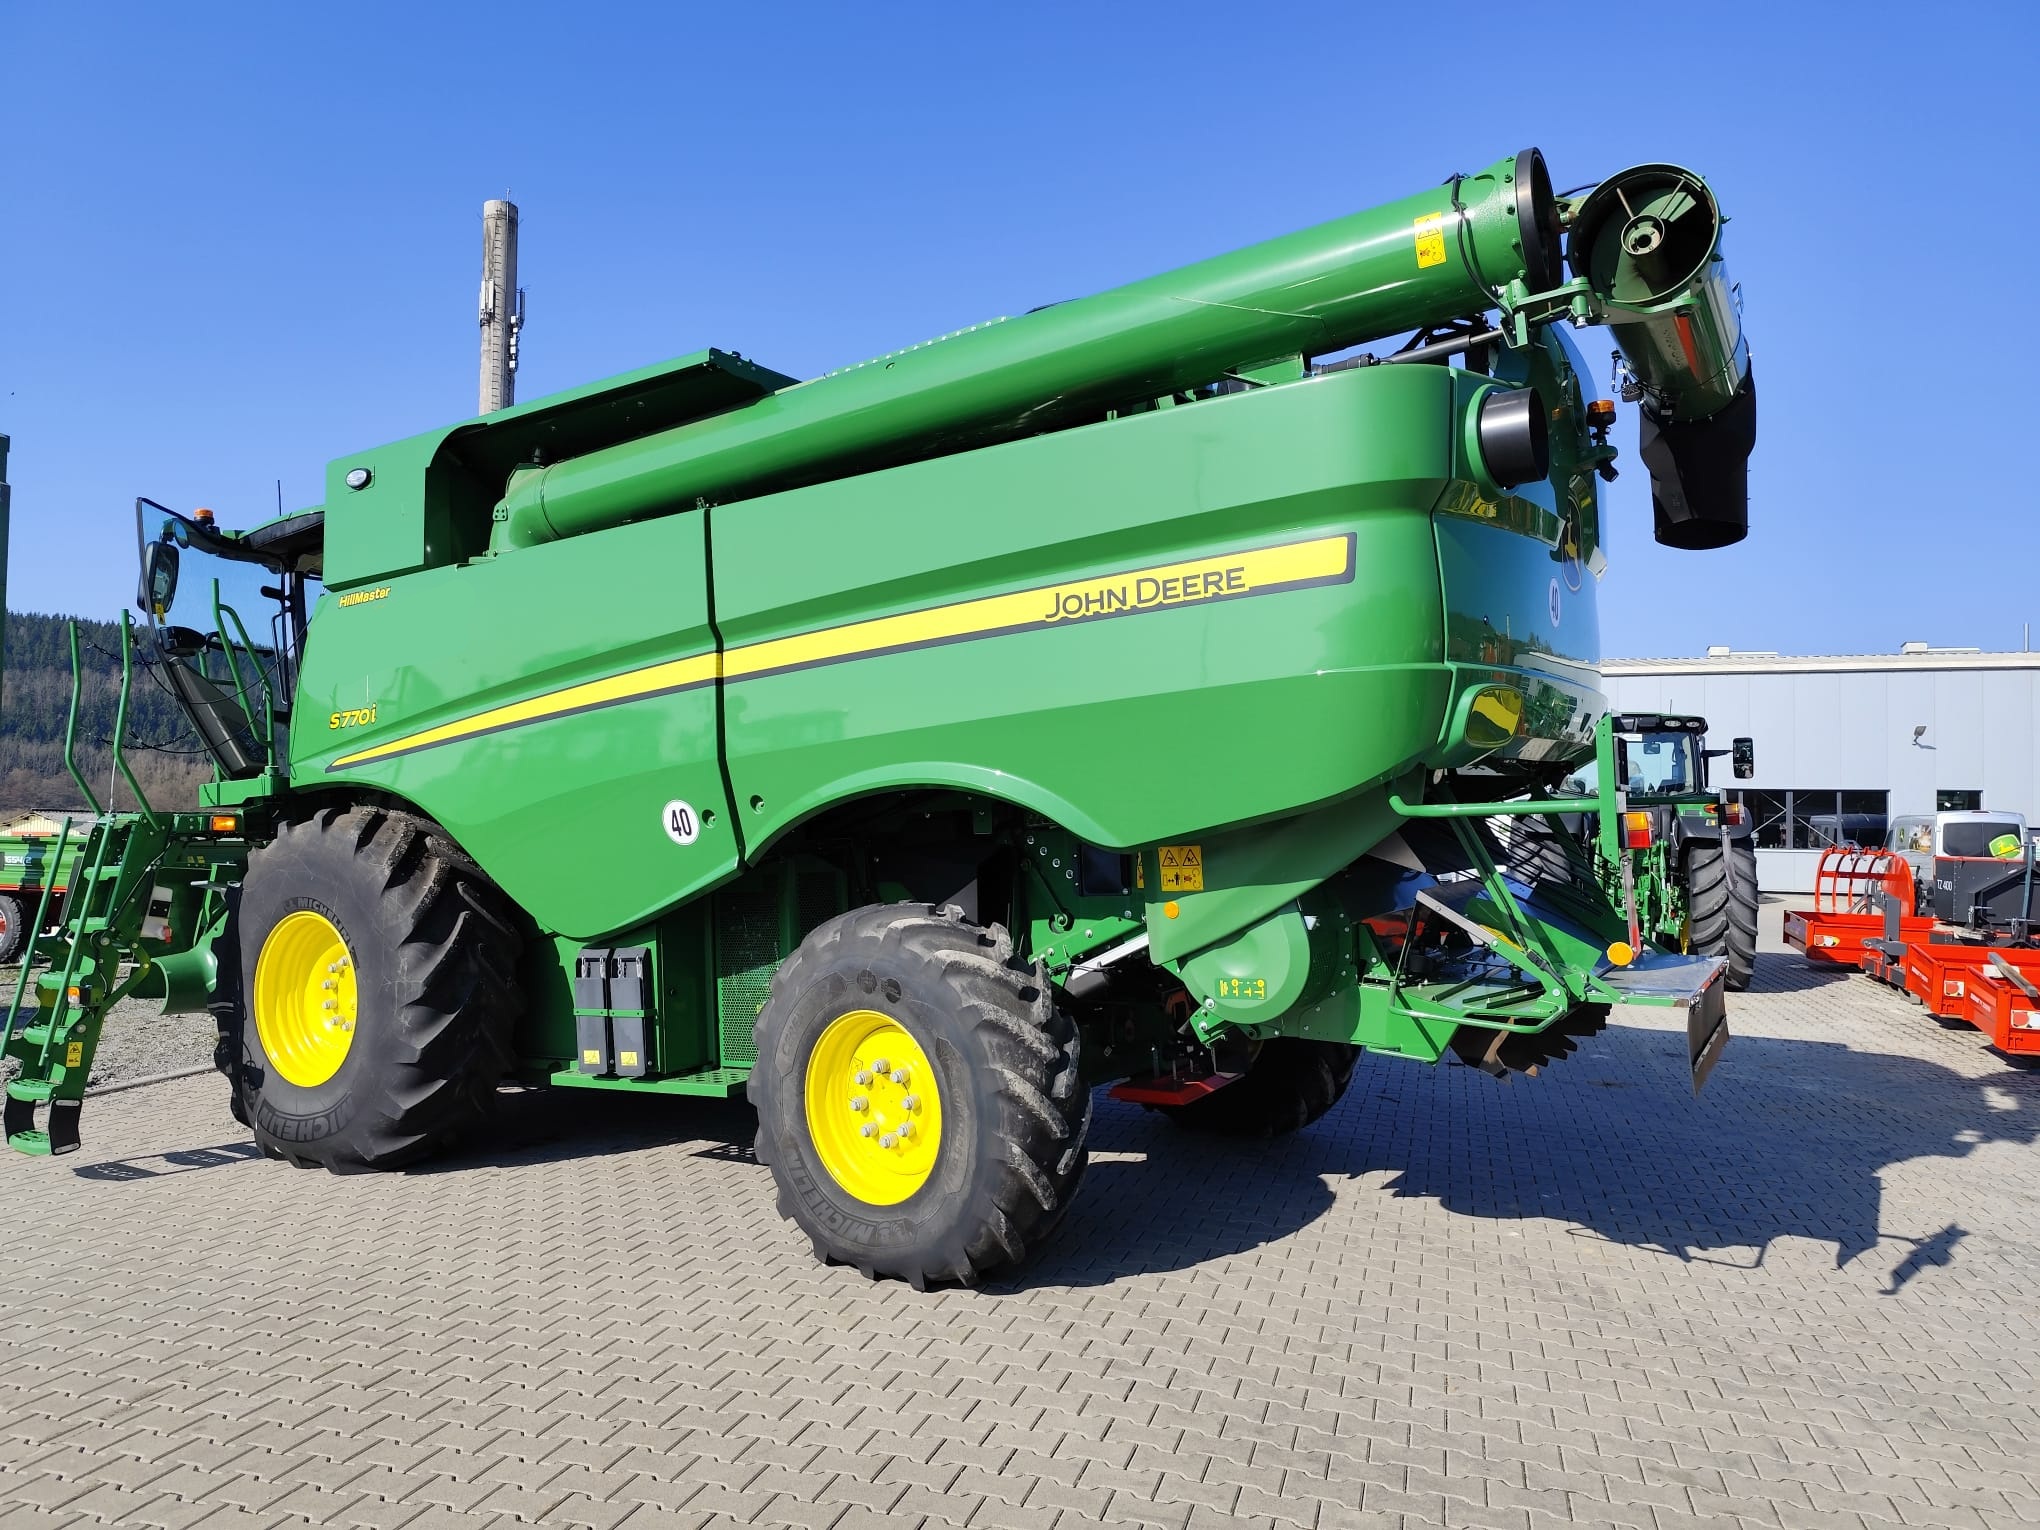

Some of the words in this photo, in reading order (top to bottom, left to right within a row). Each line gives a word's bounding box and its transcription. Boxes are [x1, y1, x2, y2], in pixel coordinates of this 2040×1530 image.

[338, 583, 391, 608] HillMaster
[1045, 586, 1128, 619] JOHN
[1136, 566, 1246, 605] DEERE
[1551, 585, 1559, 621] 40
[329, 703, 377, 729] S770i
[671, 808, 693, 837] 40
[1943, 880, 1953, 892] 400
[297, 897, 352, 946] MICHELIN
[256, 1097, 353, 1143] MICHELIN
[783, 1145, 876, 1245] MICHELIN
